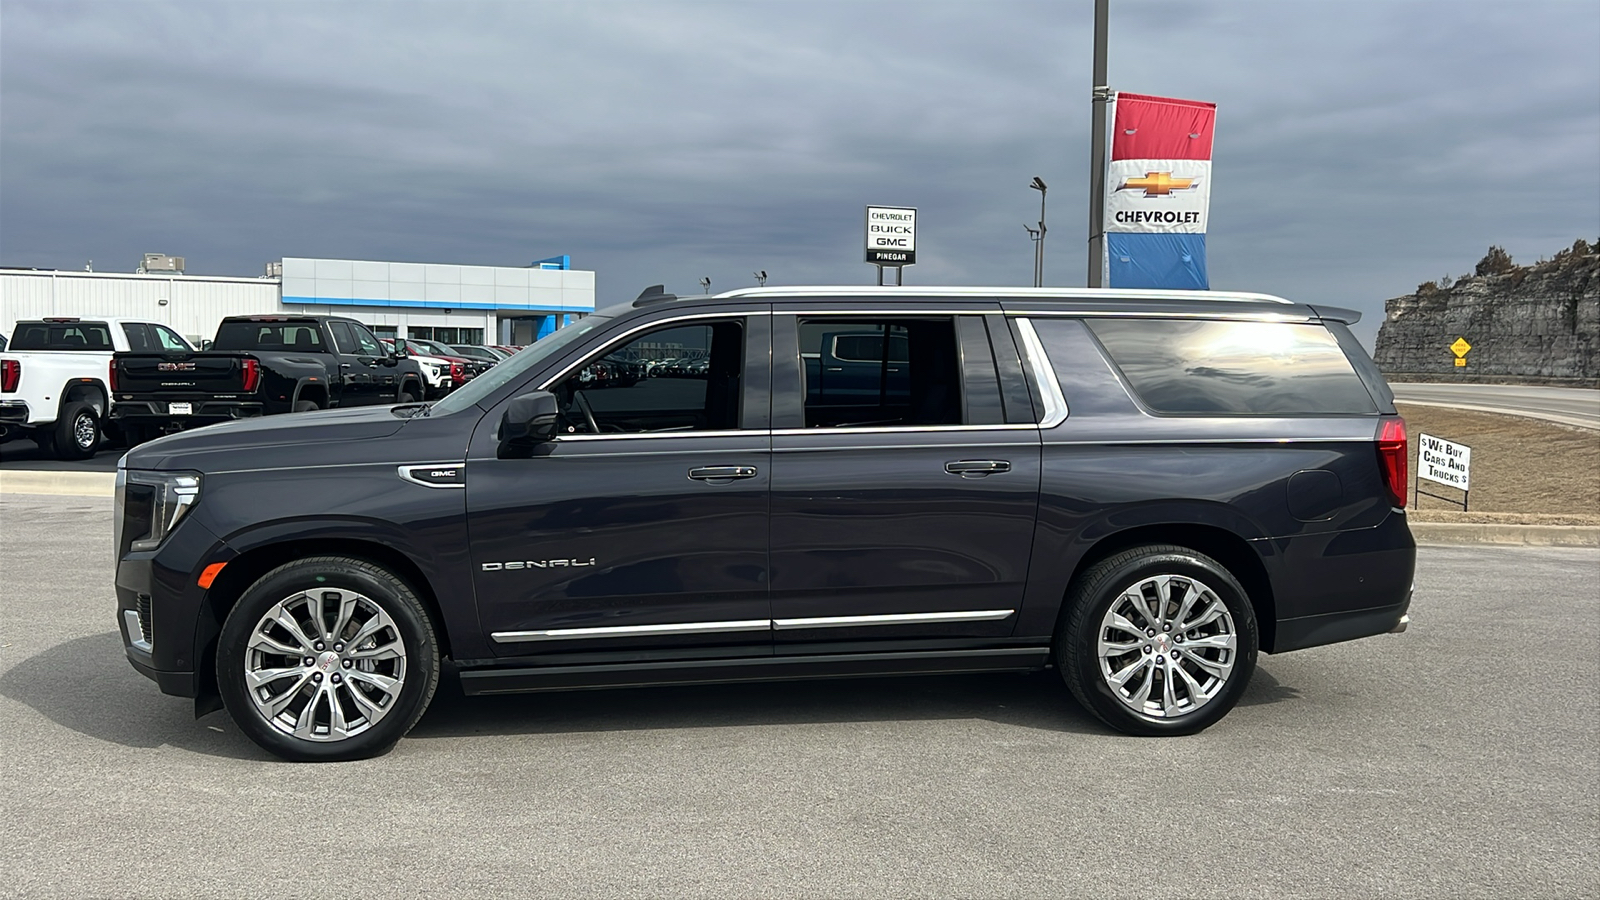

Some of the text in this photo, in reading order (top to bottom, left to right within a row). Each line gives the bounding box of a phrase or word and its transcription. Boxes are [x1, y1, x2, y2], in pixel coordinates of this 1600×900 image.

[872, 213, 912, 221] CHEVROLET
[1116, 211, 1199, 223] CHEVROLET
[871, 225, 912, 234] BUICK
[877, 238, 907, 246] GMC
[876, 253, 907, 261] PINEGAR
[158, 363, 196, 371] GMC
[481, 557, 596, 571] DENALI
